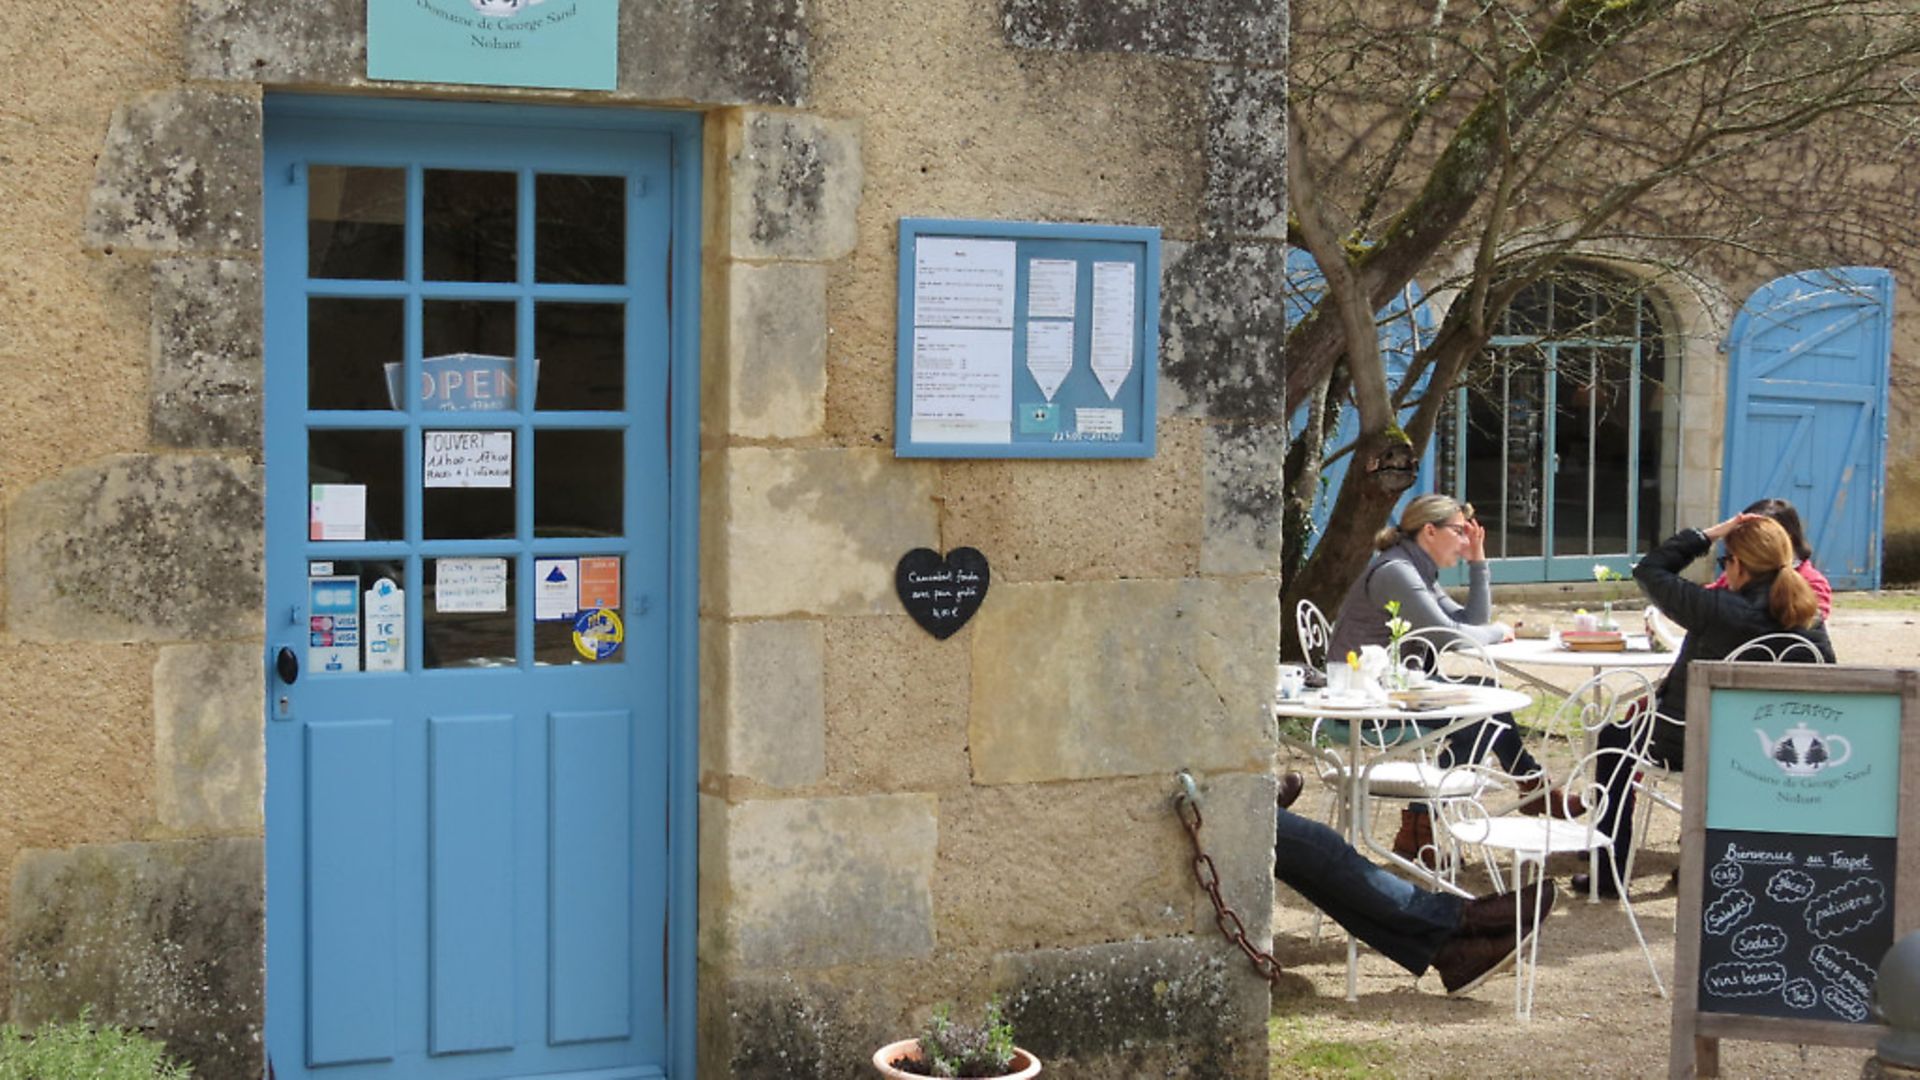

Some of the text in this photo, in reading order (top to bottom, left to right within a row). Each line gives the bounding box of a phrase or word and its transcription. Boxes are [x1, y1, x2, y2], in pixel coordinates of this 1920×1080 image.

[477, 18, 492, 31] de
[497, 20, 543, 31] George
[546, 3, 577, 24] Sand
[471, 34, 521, 50] Nohant
[434, 433, 486, 452] OUVERT
[1753, 701, 1843, 721] LE TEAPOT
[1731, 759, 1872, 789] Domaine de George Sand
[1777, 791, 1822, 804] Nohant
[1724, 843, 1795, 862] Bienvenue
[1807, 855, 1824, 863] au
